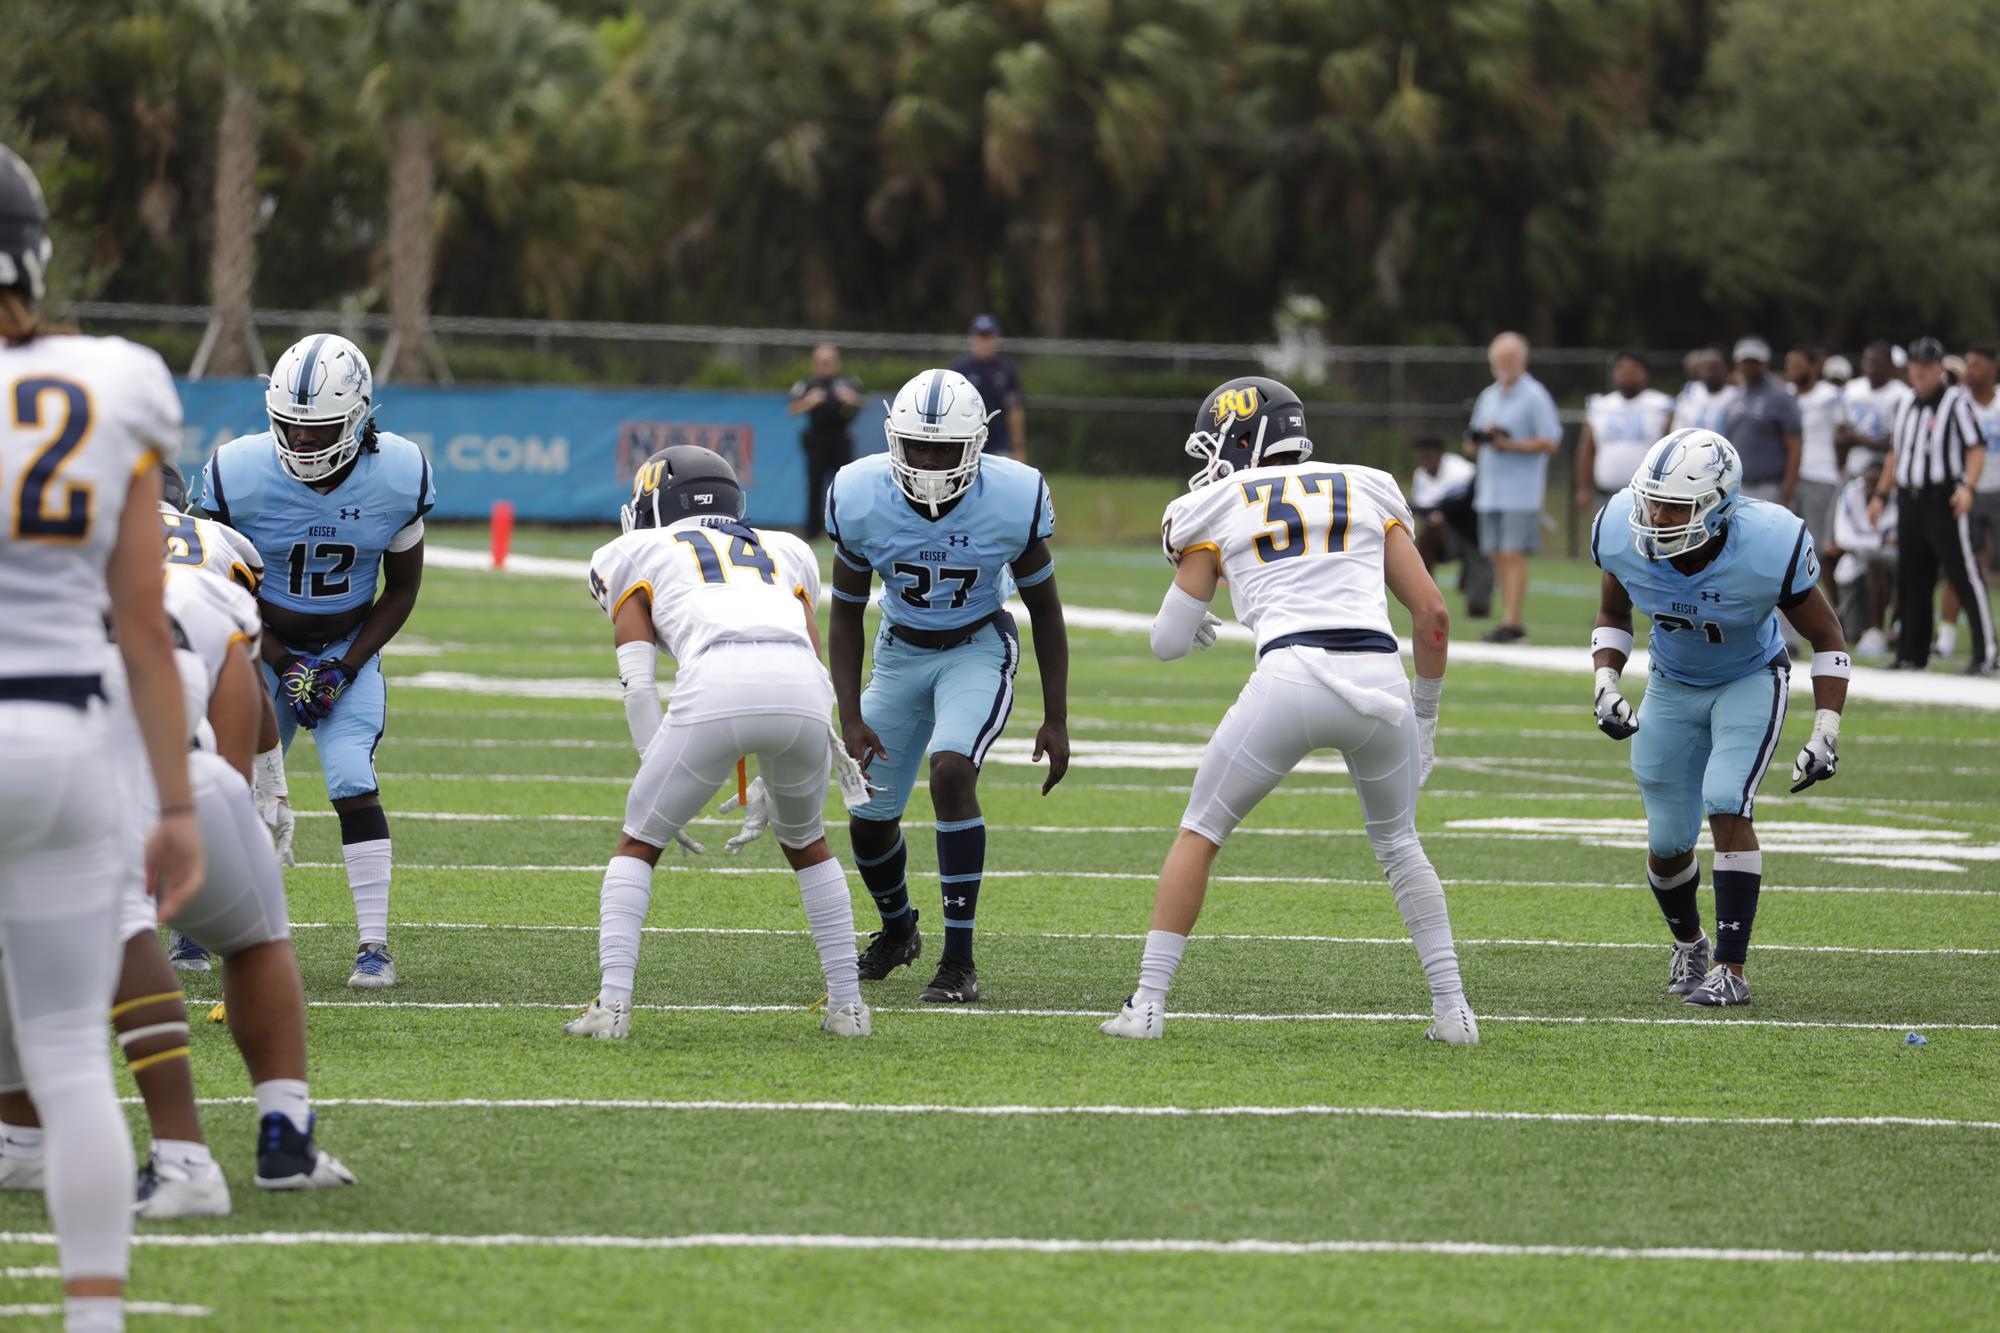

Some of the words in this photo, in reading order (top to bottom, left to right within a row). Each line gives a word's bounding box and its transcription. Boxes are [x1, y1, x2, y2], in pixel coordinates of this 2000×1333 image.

[922, 425, 940, 433] KEISER
[700, 517, 733, 528] EAGLE
[1239, 472, 1351, 564] 37
[308, 525, 337, 538] KEISER
[672, 530, 778, 585] 14
[919, 550, 948, 562] KEISER
[286, 541, 357, 599] 12
[1671, 601, 1698, 616] KEISER
